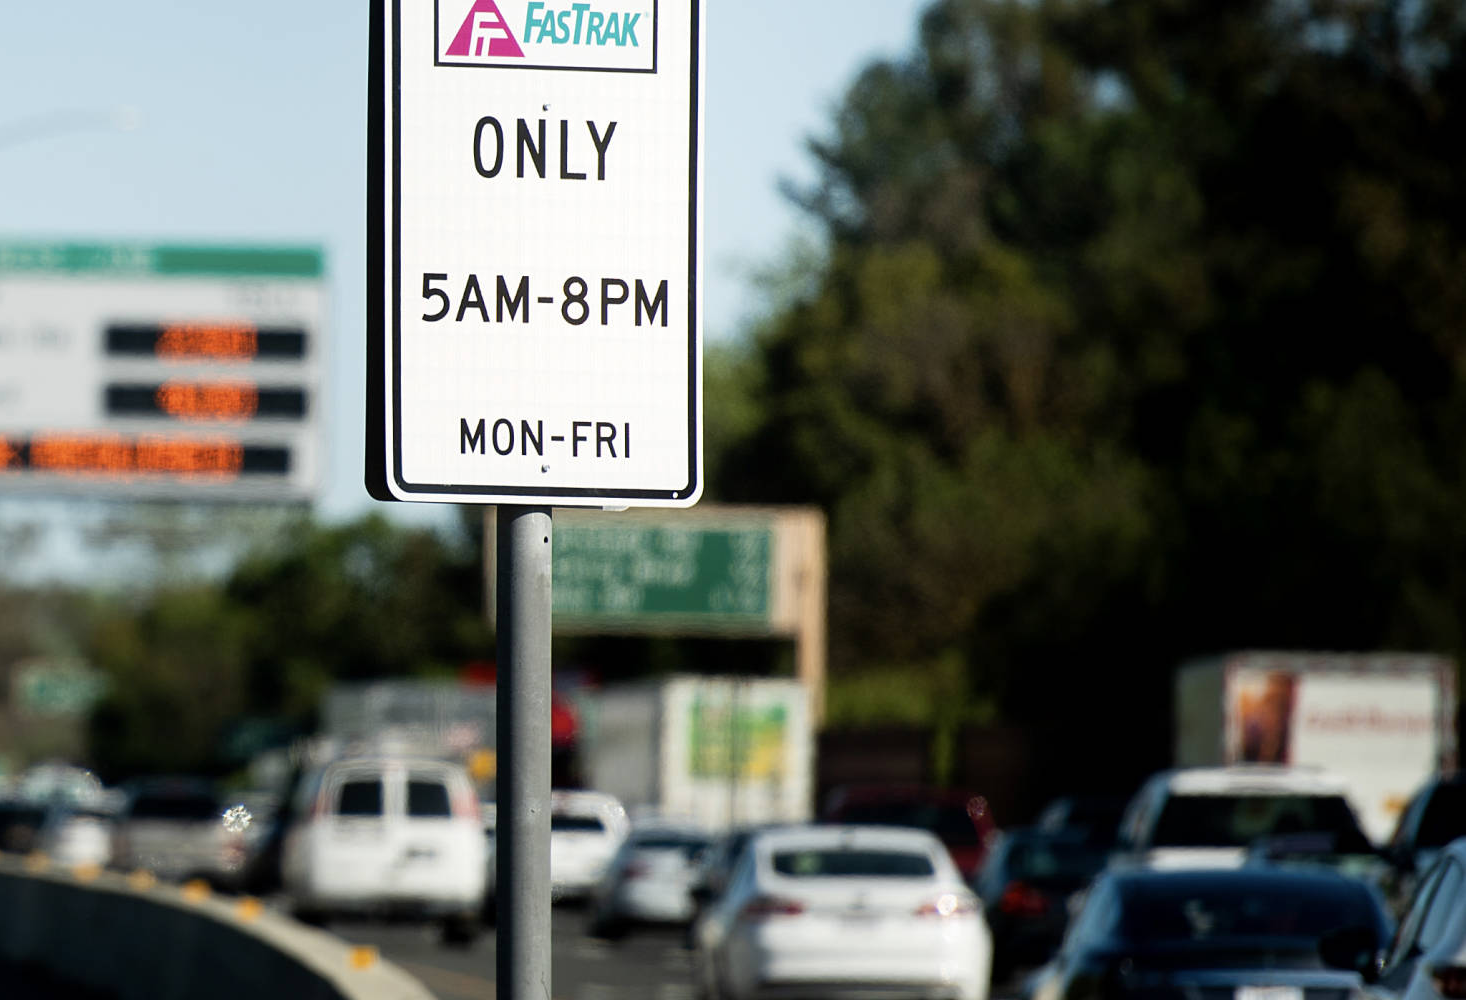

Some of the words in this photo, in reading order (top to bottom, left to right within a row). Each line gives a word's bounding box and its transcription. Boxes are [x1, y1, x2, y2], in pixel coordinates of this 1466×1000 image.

[474, 117, 617, 180] ONLY
[422, 273, 667, 327] 5AM-8PM
[461, 418, 629, 458] MON-FRI
